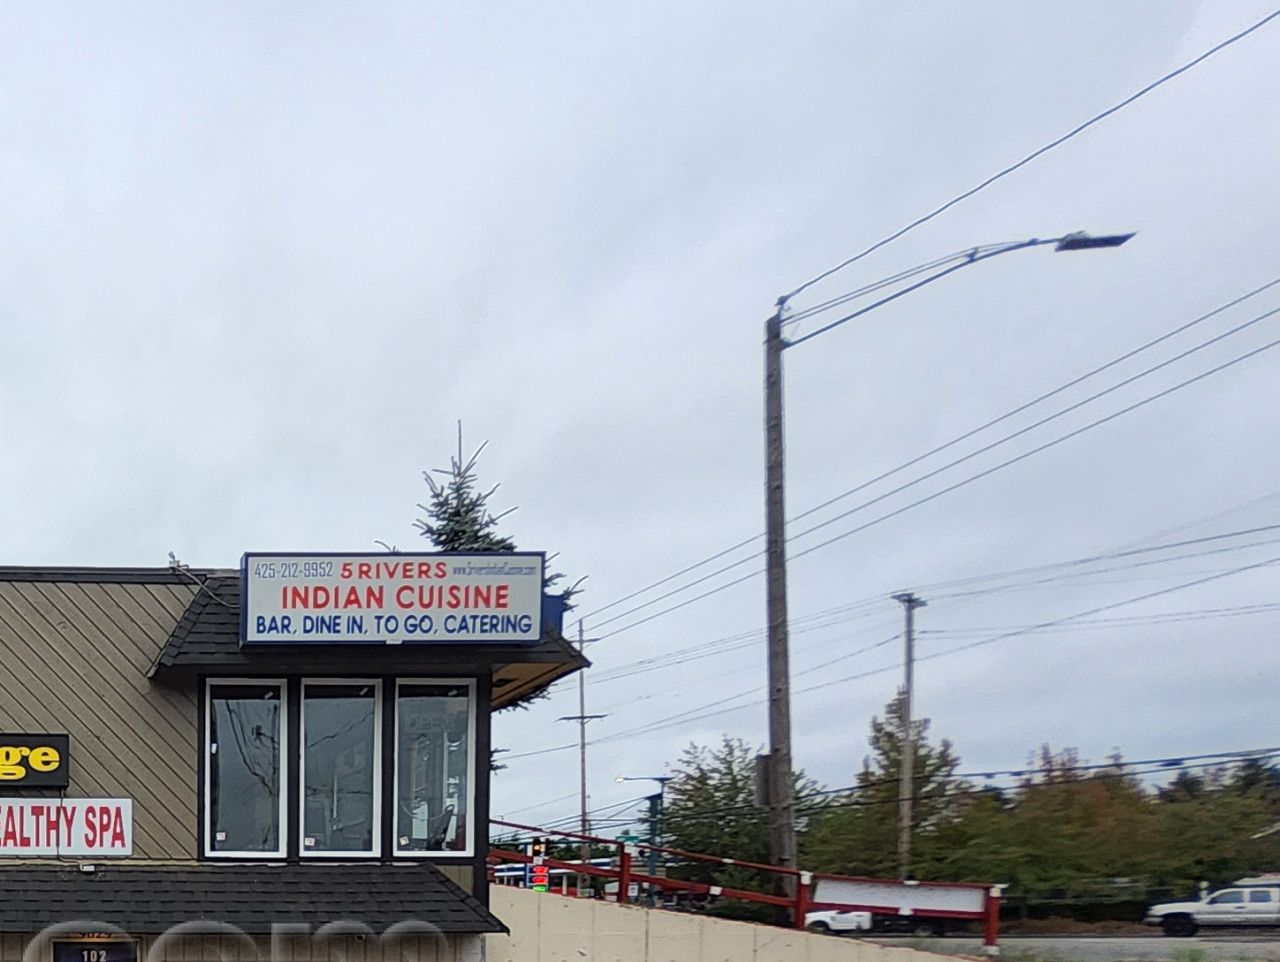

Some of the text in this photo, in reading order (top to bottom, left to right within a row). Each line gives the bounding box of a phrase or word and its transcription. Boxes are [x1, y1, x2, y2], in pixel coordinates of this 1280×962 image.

[254, 562, 333, 579] 425-212-9952
[282, 584, 509, 609] INDIAN CUISINE
[256, 614, 532, 635] BAR, DINE IN, TO GO, CATERING
[84, 806, 126, 848] SPA
[82, 950, 107, 962] 102
